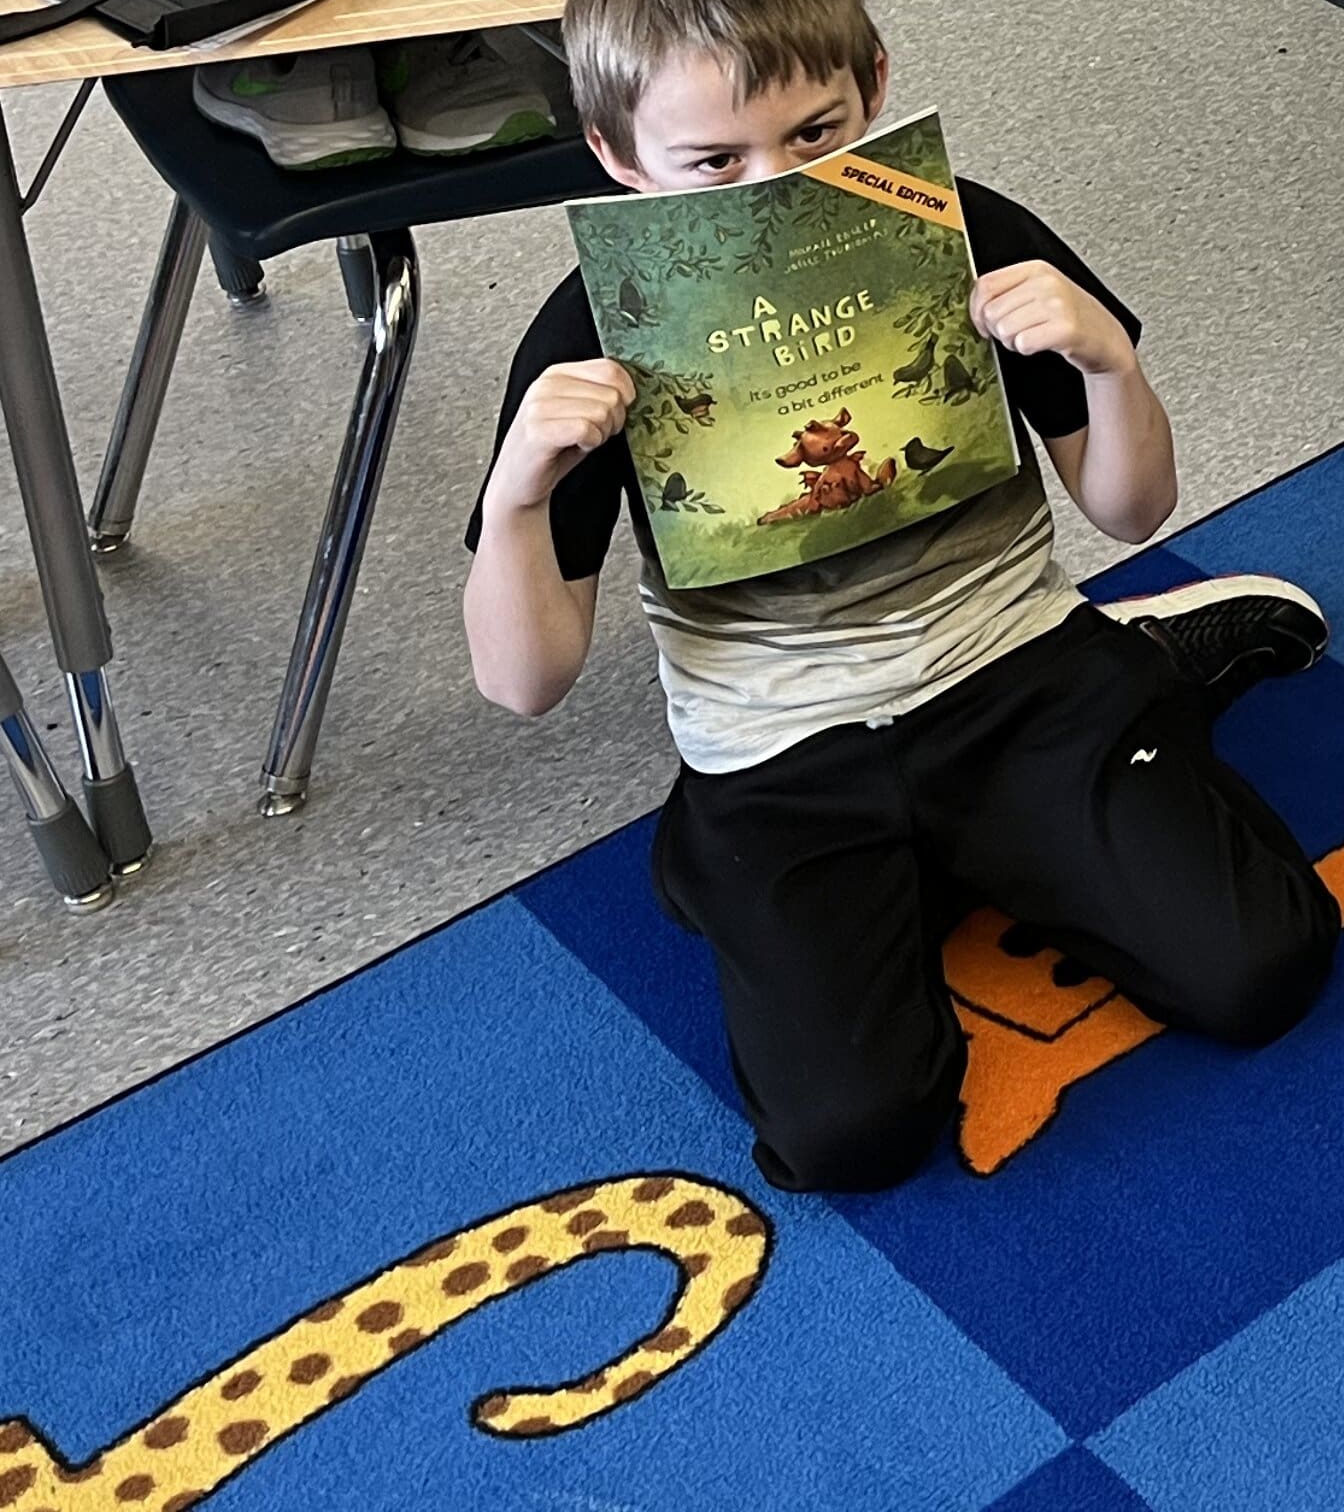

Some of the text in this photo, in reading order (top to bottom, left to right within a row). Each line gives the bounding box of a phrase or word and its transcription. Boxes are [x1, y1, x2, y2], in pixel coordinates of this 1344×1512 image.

[841, 165, 949, 213] SPECIAL EDITION
[706, 288, 876, 355] STRANGE
[752, 295, 778, 320] A
[775, 374, 818, 398] good
[821, 370, 839, 382] to
[840, 362, 861, 376] be
[777, 373, 884, 415] a bit different
